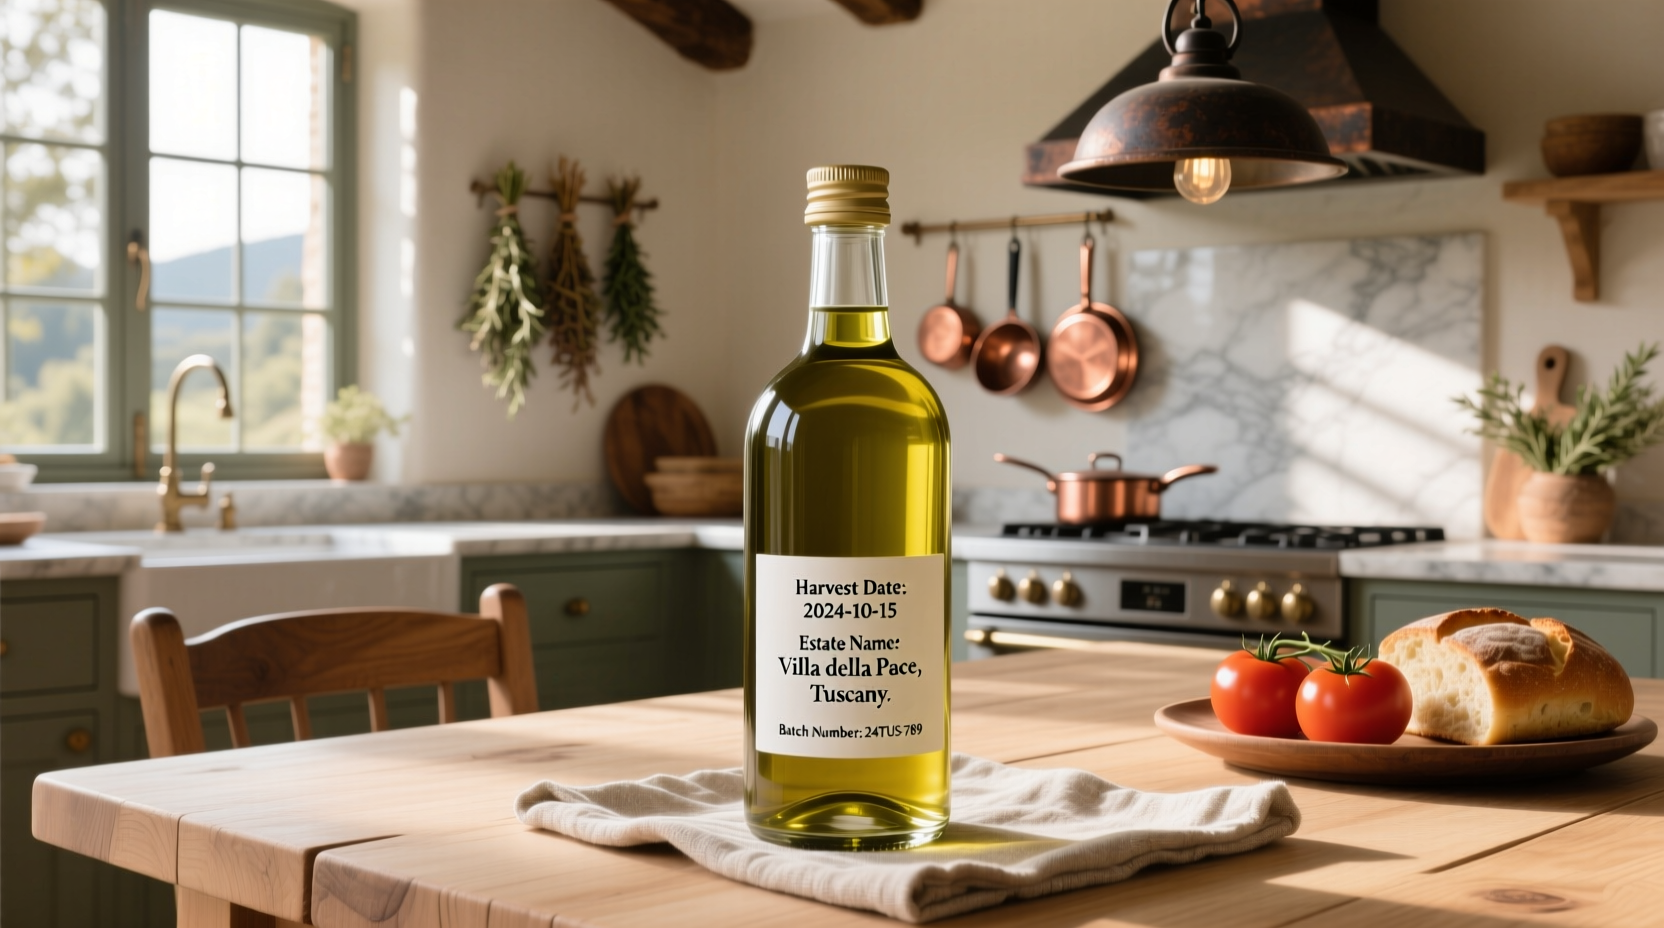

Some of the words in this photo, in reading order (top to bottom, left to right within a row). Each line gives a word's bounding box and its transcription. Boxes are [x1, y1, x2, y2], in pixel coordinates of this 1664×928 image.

[795, 578, 860, 596] Harvest
[863, 578, 908, 596] Date:
[803, 602, 898, 619] 2024-10-15
[799, 634, 847, 651] Estate
[849, 634, 901, 651] Name:
[777, 656, 822, 677] Villa
[825, 656, 873, 678] della
[876, 656, 923, 678] Pace,
[809, 683, 892, 709] Tuscany.
[779, 723, 809, 738] Batch
[811, 725, 863, 739] Number:
